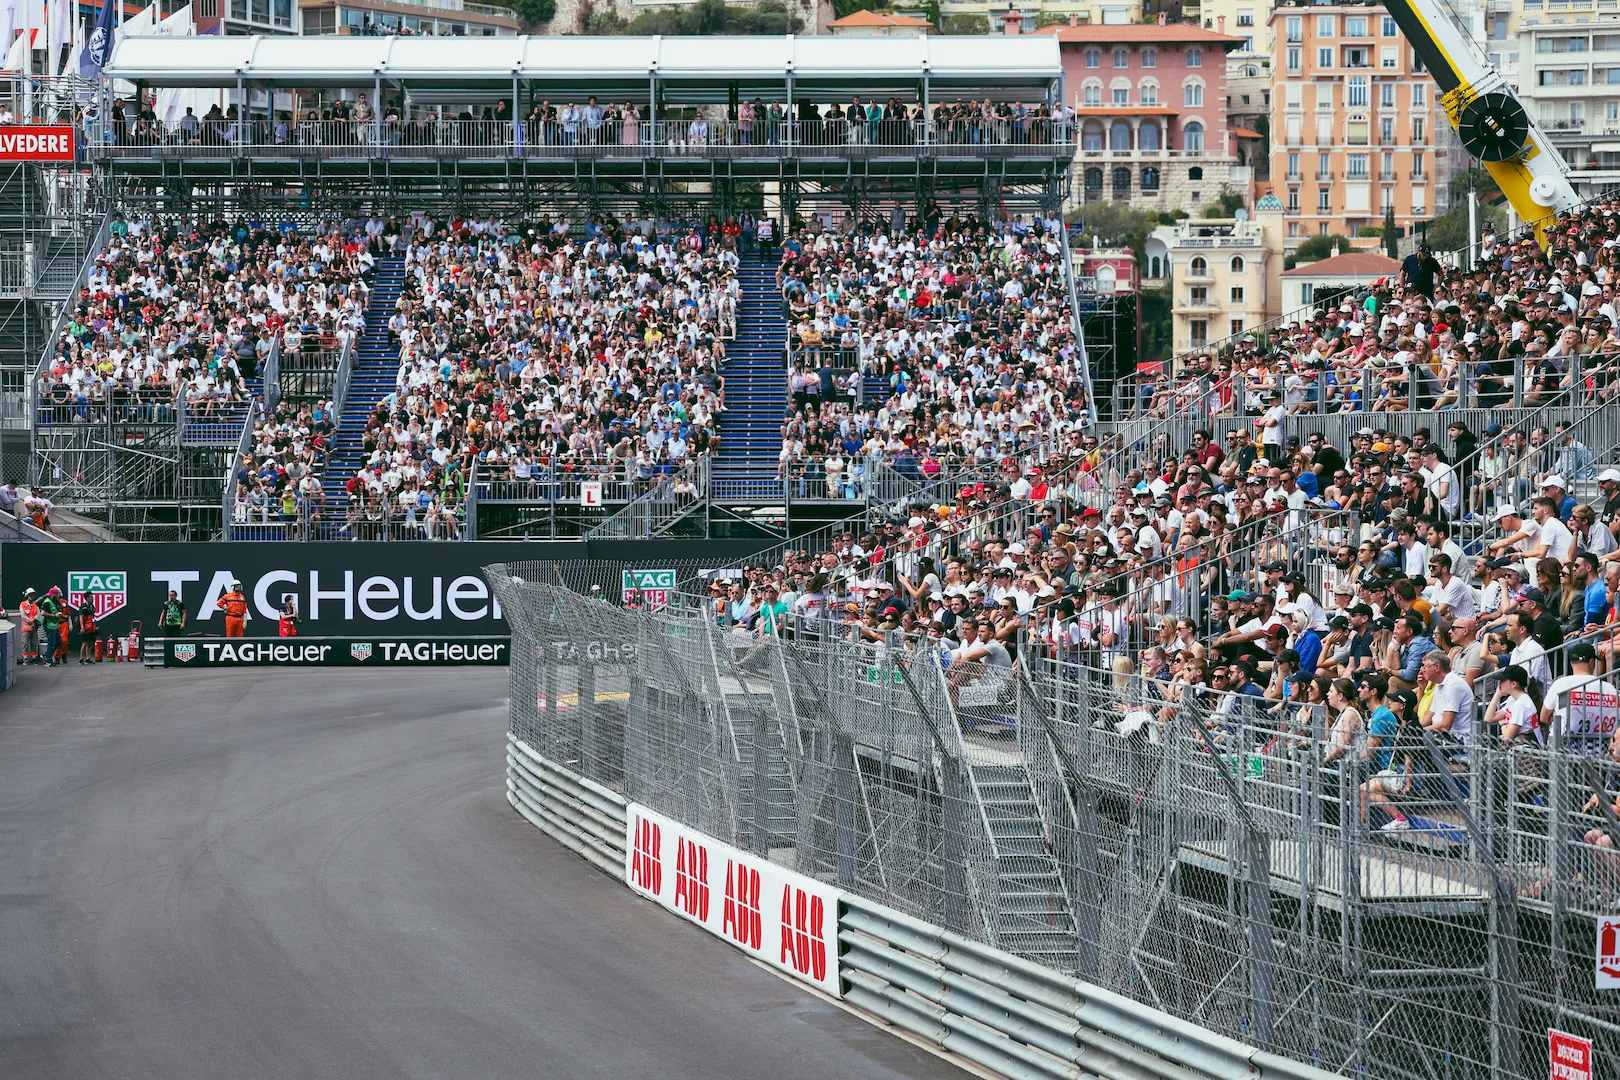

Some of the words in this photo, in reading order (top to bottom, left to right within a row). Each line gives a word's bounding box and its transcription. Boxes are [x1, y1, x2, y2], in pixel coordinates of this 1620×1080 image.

[587, 491, 596, 503] L
[73, 575, 121, 590] TAG
[151, 569, 502, 621] TAGHeue
[626, 572, 671, 587] TAG
[72, 594, 123, 617] HUER
[1578, 719, 1591, 733] 23
[632, 814, 662, 896] ABB
[675, 836, 710, 923] ABB
[723, 859, 762, 951] ABB
[780, 884, 827, 982] ABB
